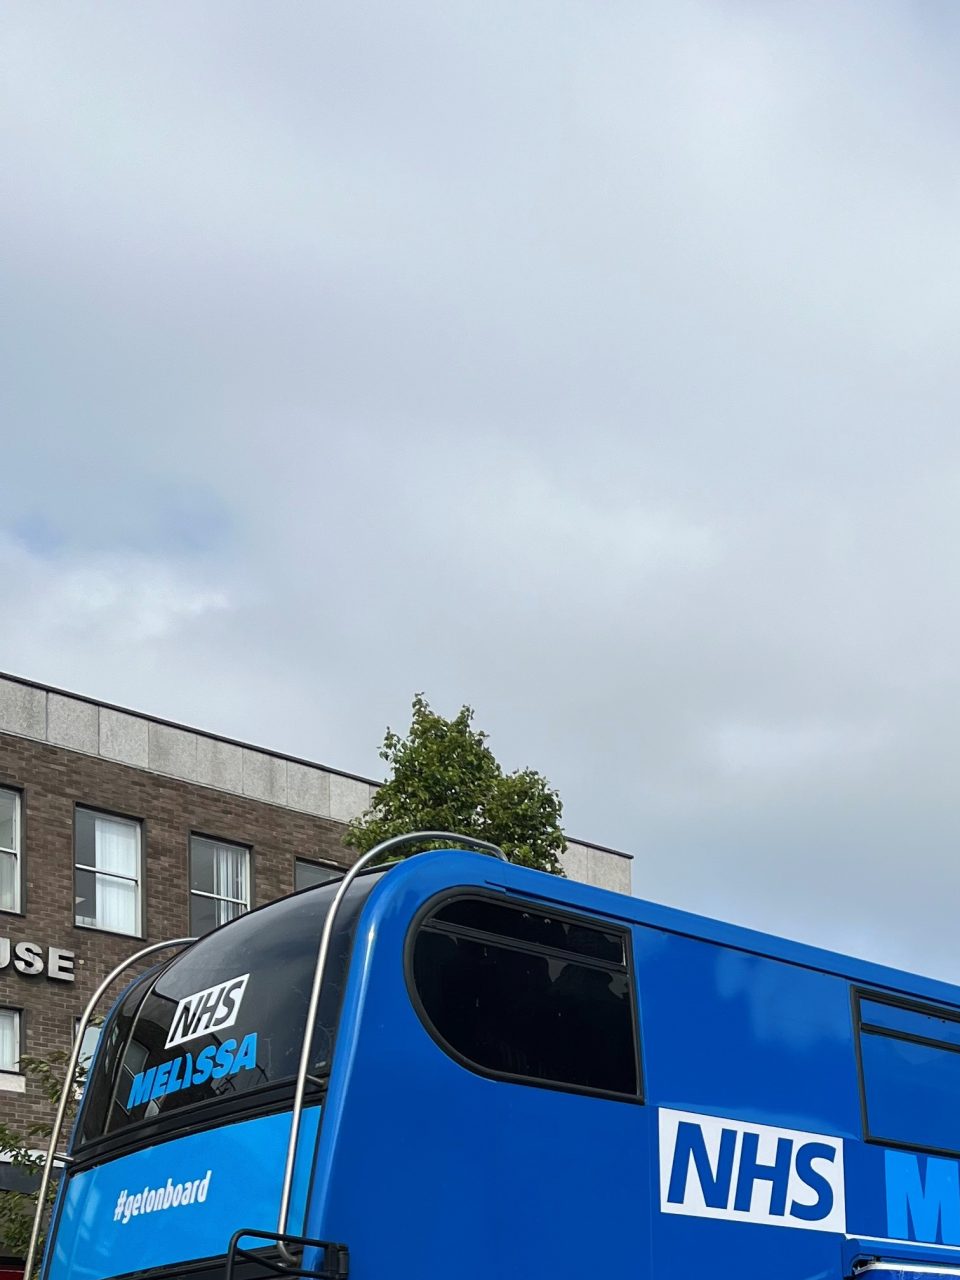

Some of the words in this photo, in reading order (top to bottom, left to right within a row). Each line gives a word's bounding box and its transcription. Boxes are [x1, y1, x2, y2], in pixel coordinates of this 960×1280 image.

[168, 980, 246, 1044] NHS
[127, 1032, 258, 1110] MELISSA
[113, 1169, 213, 1225] #getonboard
[667, 1120, 836, 1221] NHS
